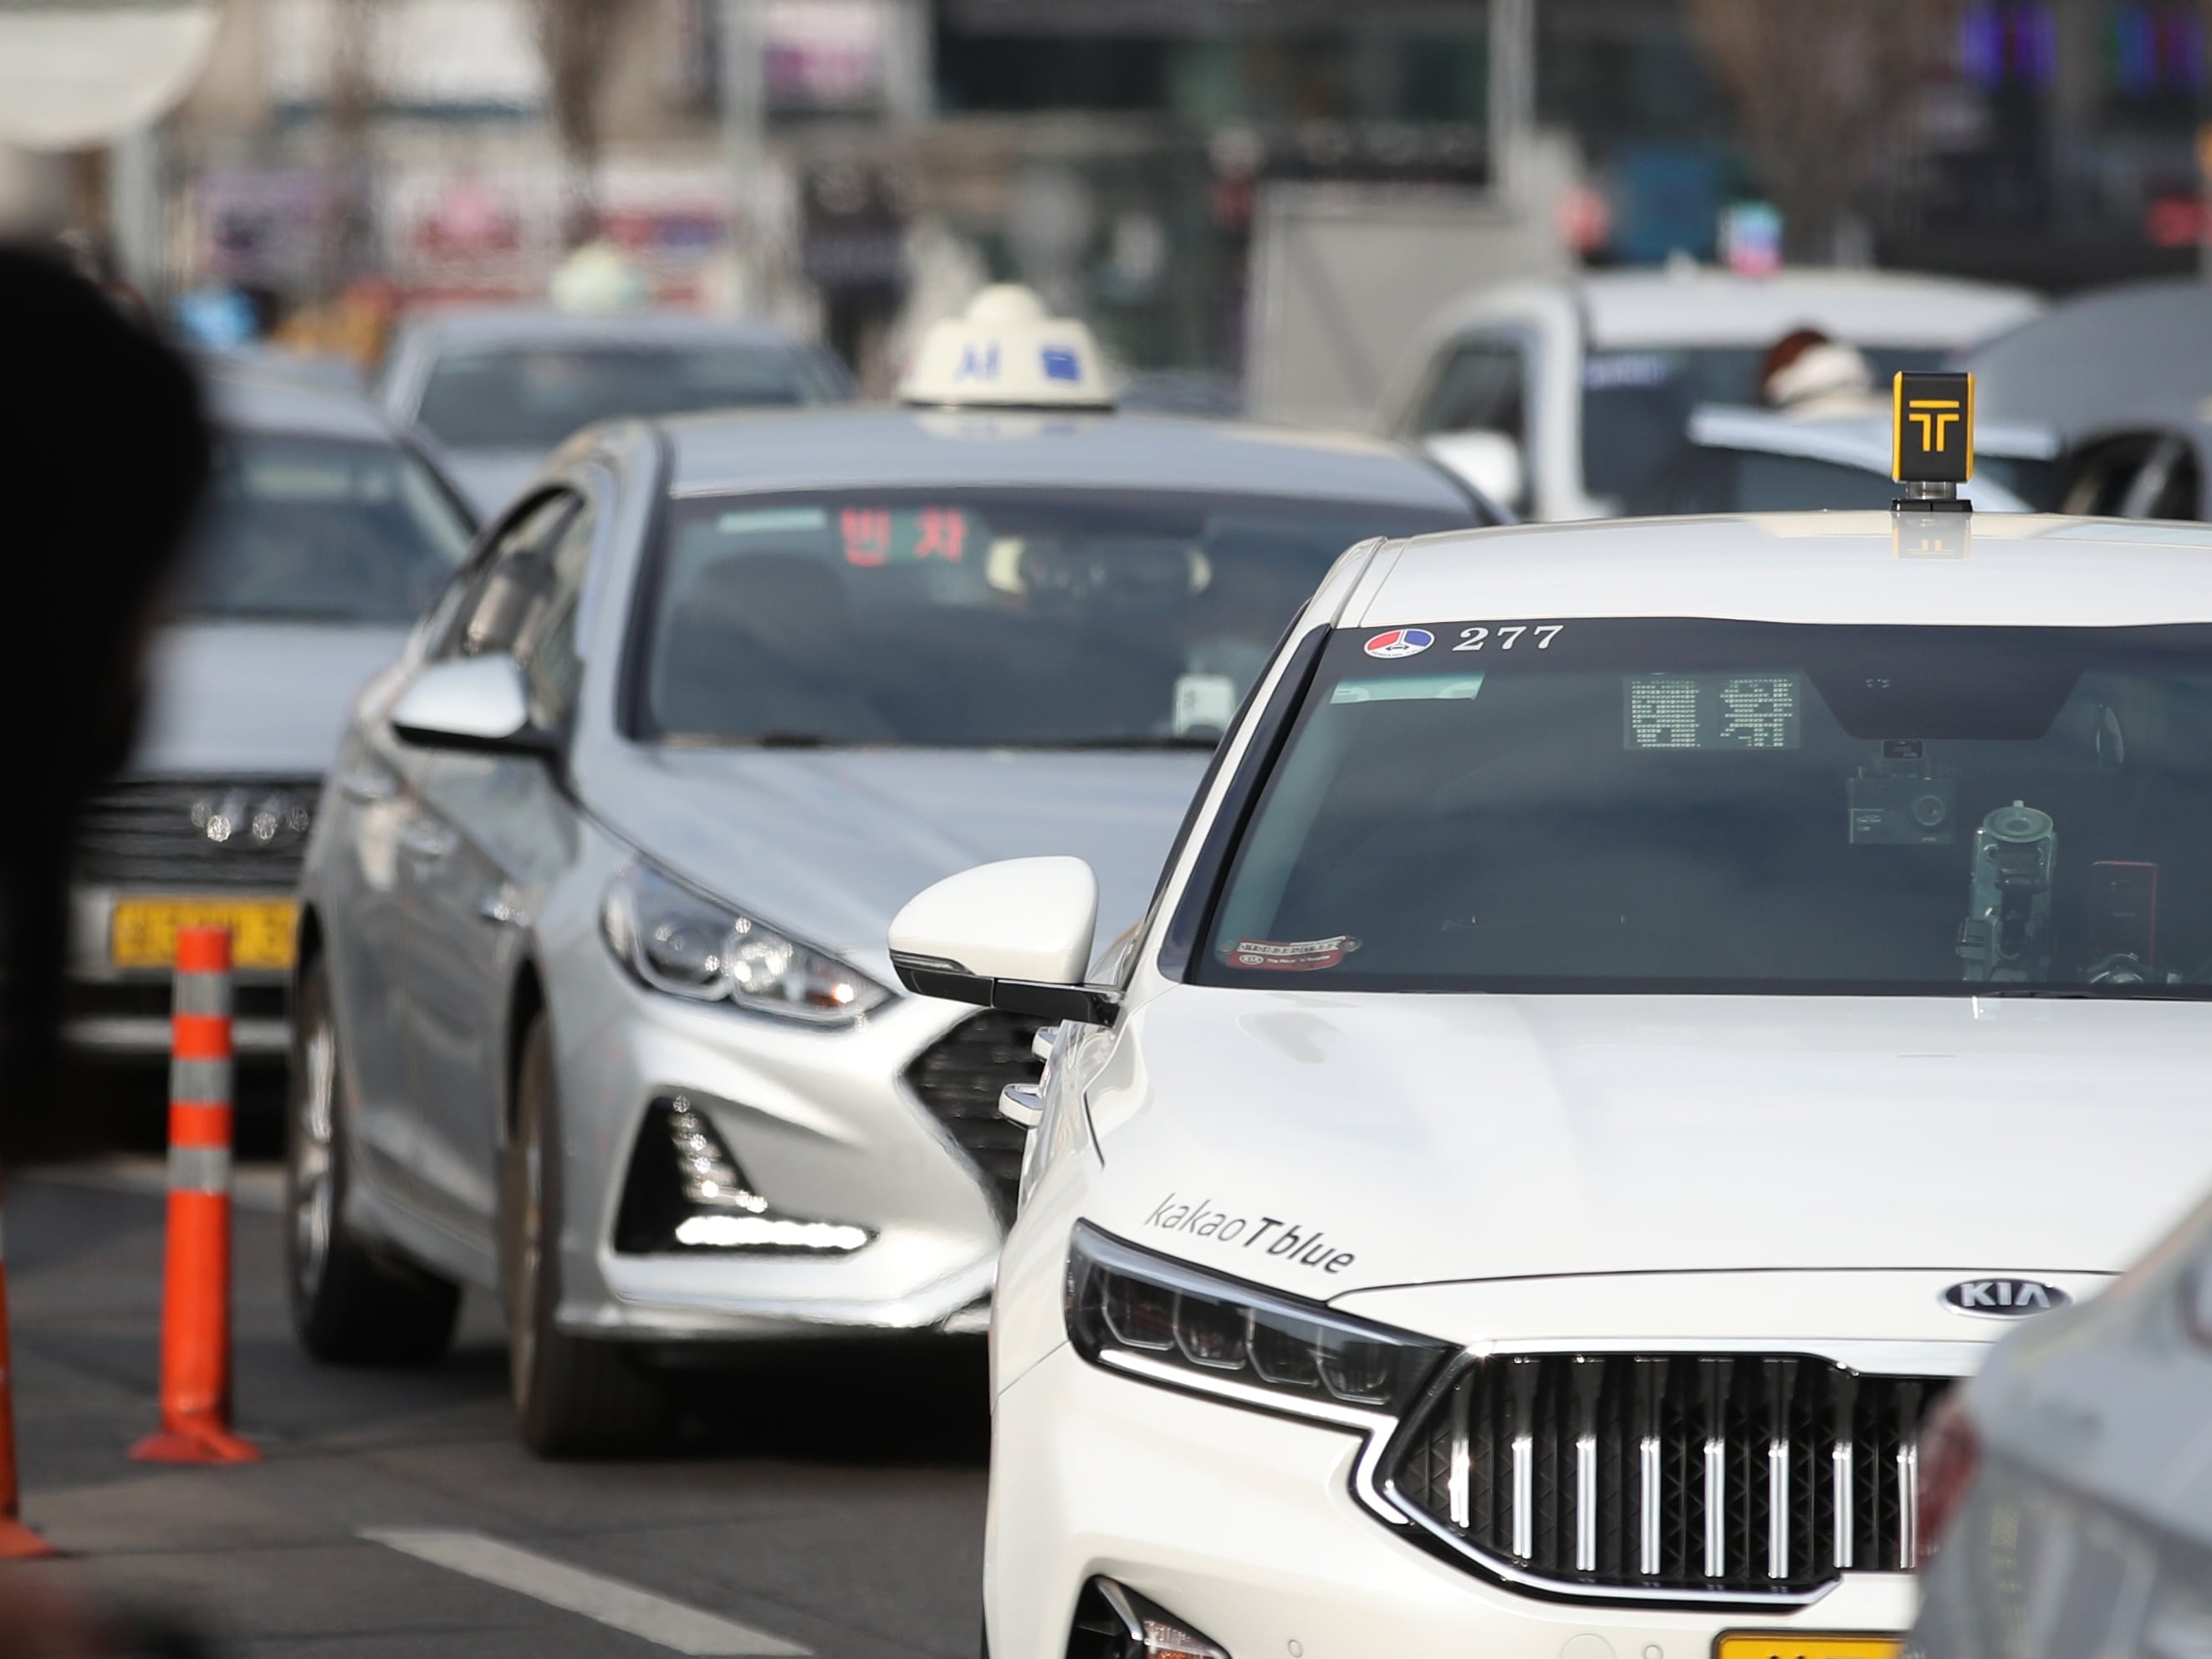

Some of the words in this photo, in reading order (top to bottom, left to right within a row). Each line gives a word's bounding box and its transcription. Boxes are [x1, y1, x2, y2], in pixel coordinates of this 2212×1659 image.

[1452, 625, 1565, 651] 277
[1144, 1192, 1247, 1242] kakao
[1264, 1224, 1356, 1274] blue
[1960, 1281, 2051, 1309] KIA
